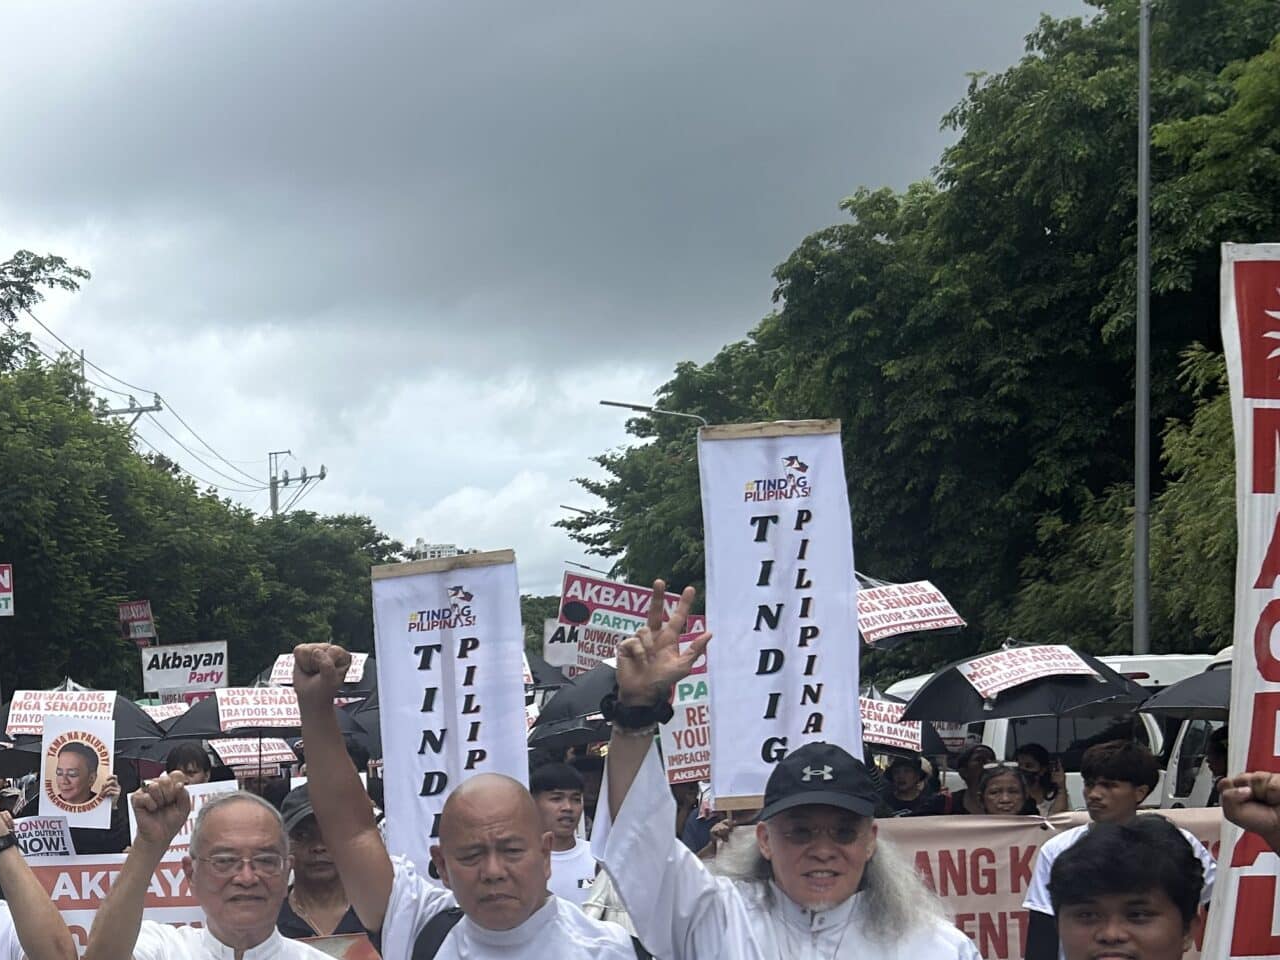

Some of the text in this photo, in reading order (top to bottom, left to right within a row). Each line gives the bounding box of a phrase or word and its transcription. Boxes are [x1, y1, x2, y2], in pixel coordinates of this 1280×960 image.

[859, 587, 898, 602] UWAG
[882, 591, 947, 610] SENADOR!
[592, 612, 645, 632] PARTY
[794, 509, 823, 736] PILIPINA
[584, 629, 619, 645] DUWAG
[751, 514, 789, 764] TINDIG
[577, 640, 595, 655] MGA
[147, 651, 224, 671] Akbayan
[968, 645, 1062, 670] DUWAG ANG
[188, 671, 224, 684] Party
[967, 665, 1003, 682] MGA
[75, 692, 105, 701] ANG
[220, 695, 297, 706] MGA SENAD
[457, 637, 487, 770] PILIP
[12, 701, 112, 713] MGA SENADOR!
[221, 708, 283, 719] TRAYDOR SA
[887, 704, 906, 715] AN
[10, 713, 45, 723] TRAYD
[873, 723, 885, 734] SA
[886, 725, 920, 740] BAYAN!
[47, 734, 66, 758] TAMA
[67, 731, 80, 741] NA
[668, 751, 710, 766] IMPEACH
[672, 768, 710, 781] AKBAY
[35, 829, 65, 838] DUTERTE
[17, 836, 67, 854] NOW!
[914, 846, 997, 897] ANG
